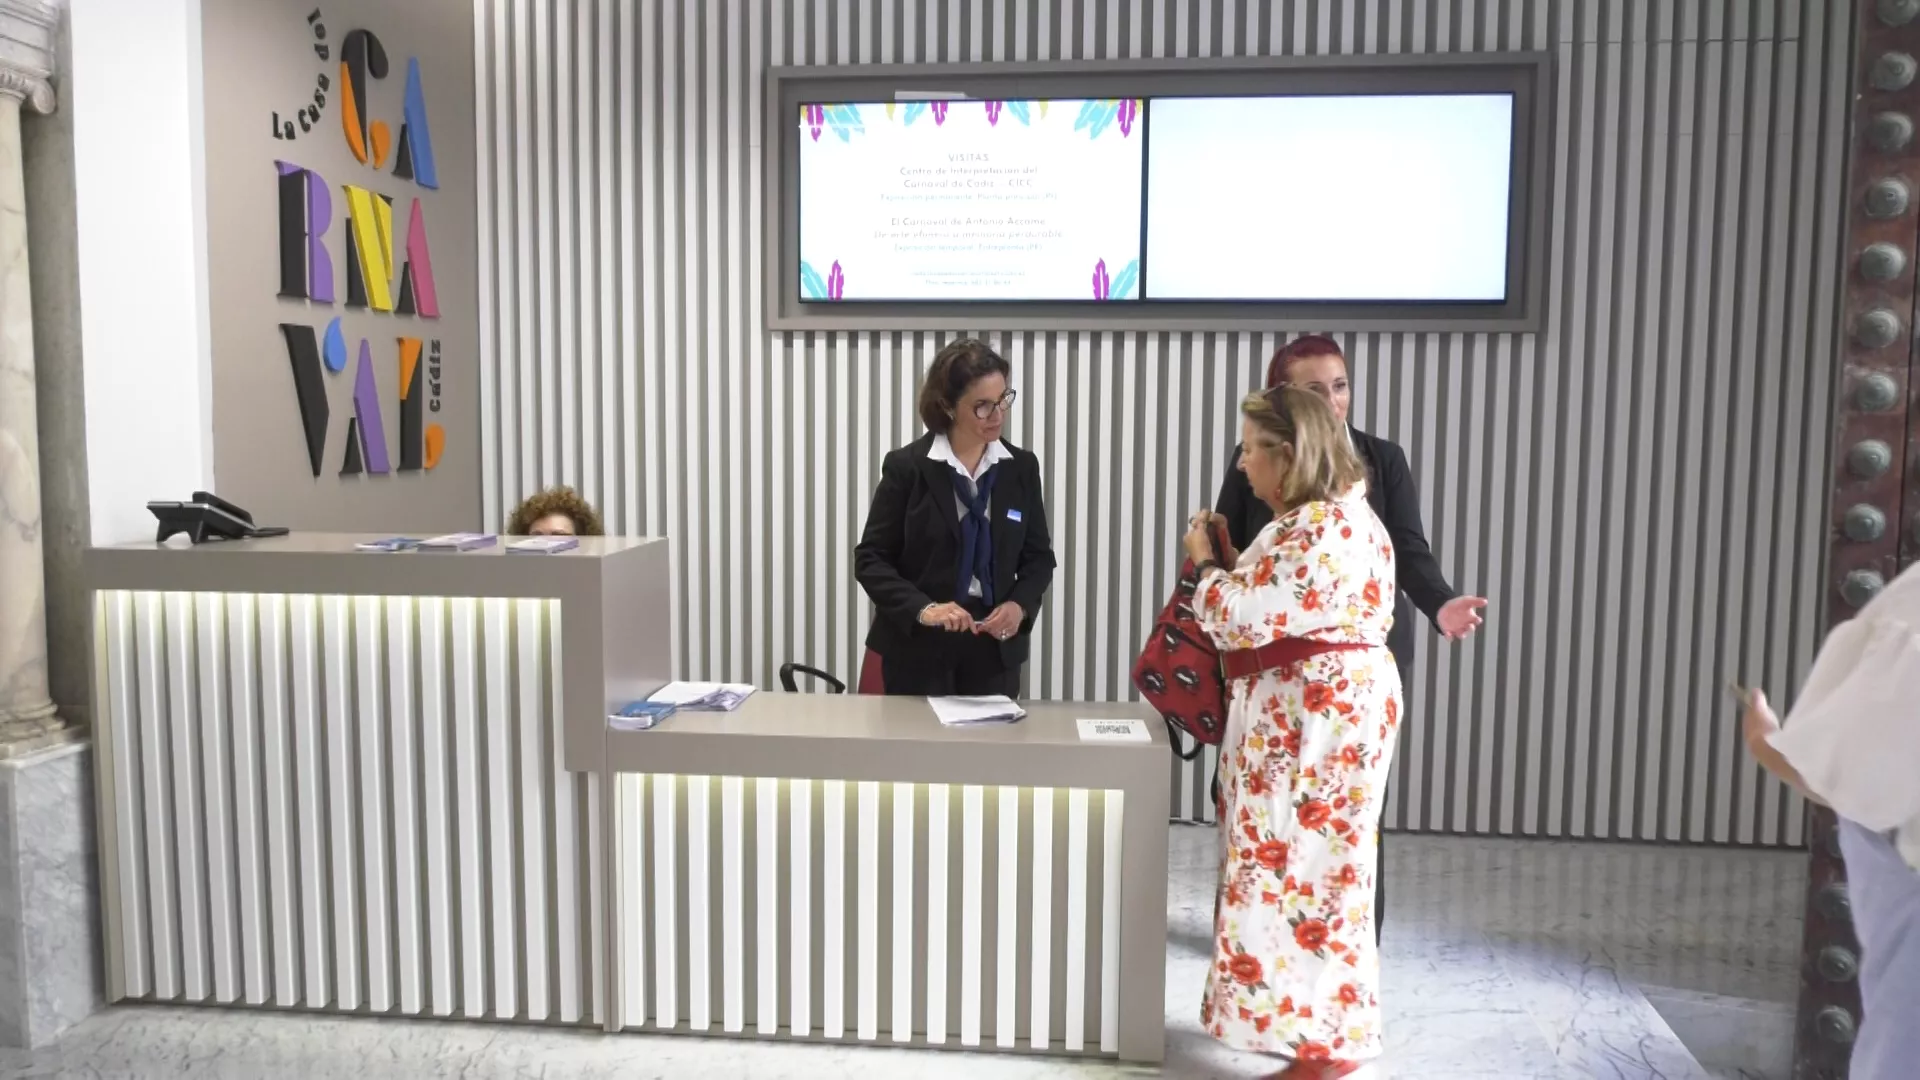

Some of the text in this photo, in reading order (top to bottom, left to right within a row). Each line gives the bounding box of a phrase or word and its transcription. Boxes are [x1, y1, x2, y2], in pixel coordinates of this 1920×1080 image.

[272, 111, 296, 140] La
[307, 7, 330, 61] del
[948, 153, 990, 162] VISITAS
[900, 166, 932, 176] Centro
[935, 167, 947, 175] de
[1022, 165, 1038, 174] del
[903, 179, 948, 188] Carnaval
[951, 179, 964, 188] de
[891, 217, 900, 226] El
[902, 217, 947, 226] Carnaval
[950, 217, 962, 226] de
[965, 217, 1004, 226] Antonio
[1008, 228, 1063, 240] perdurable
